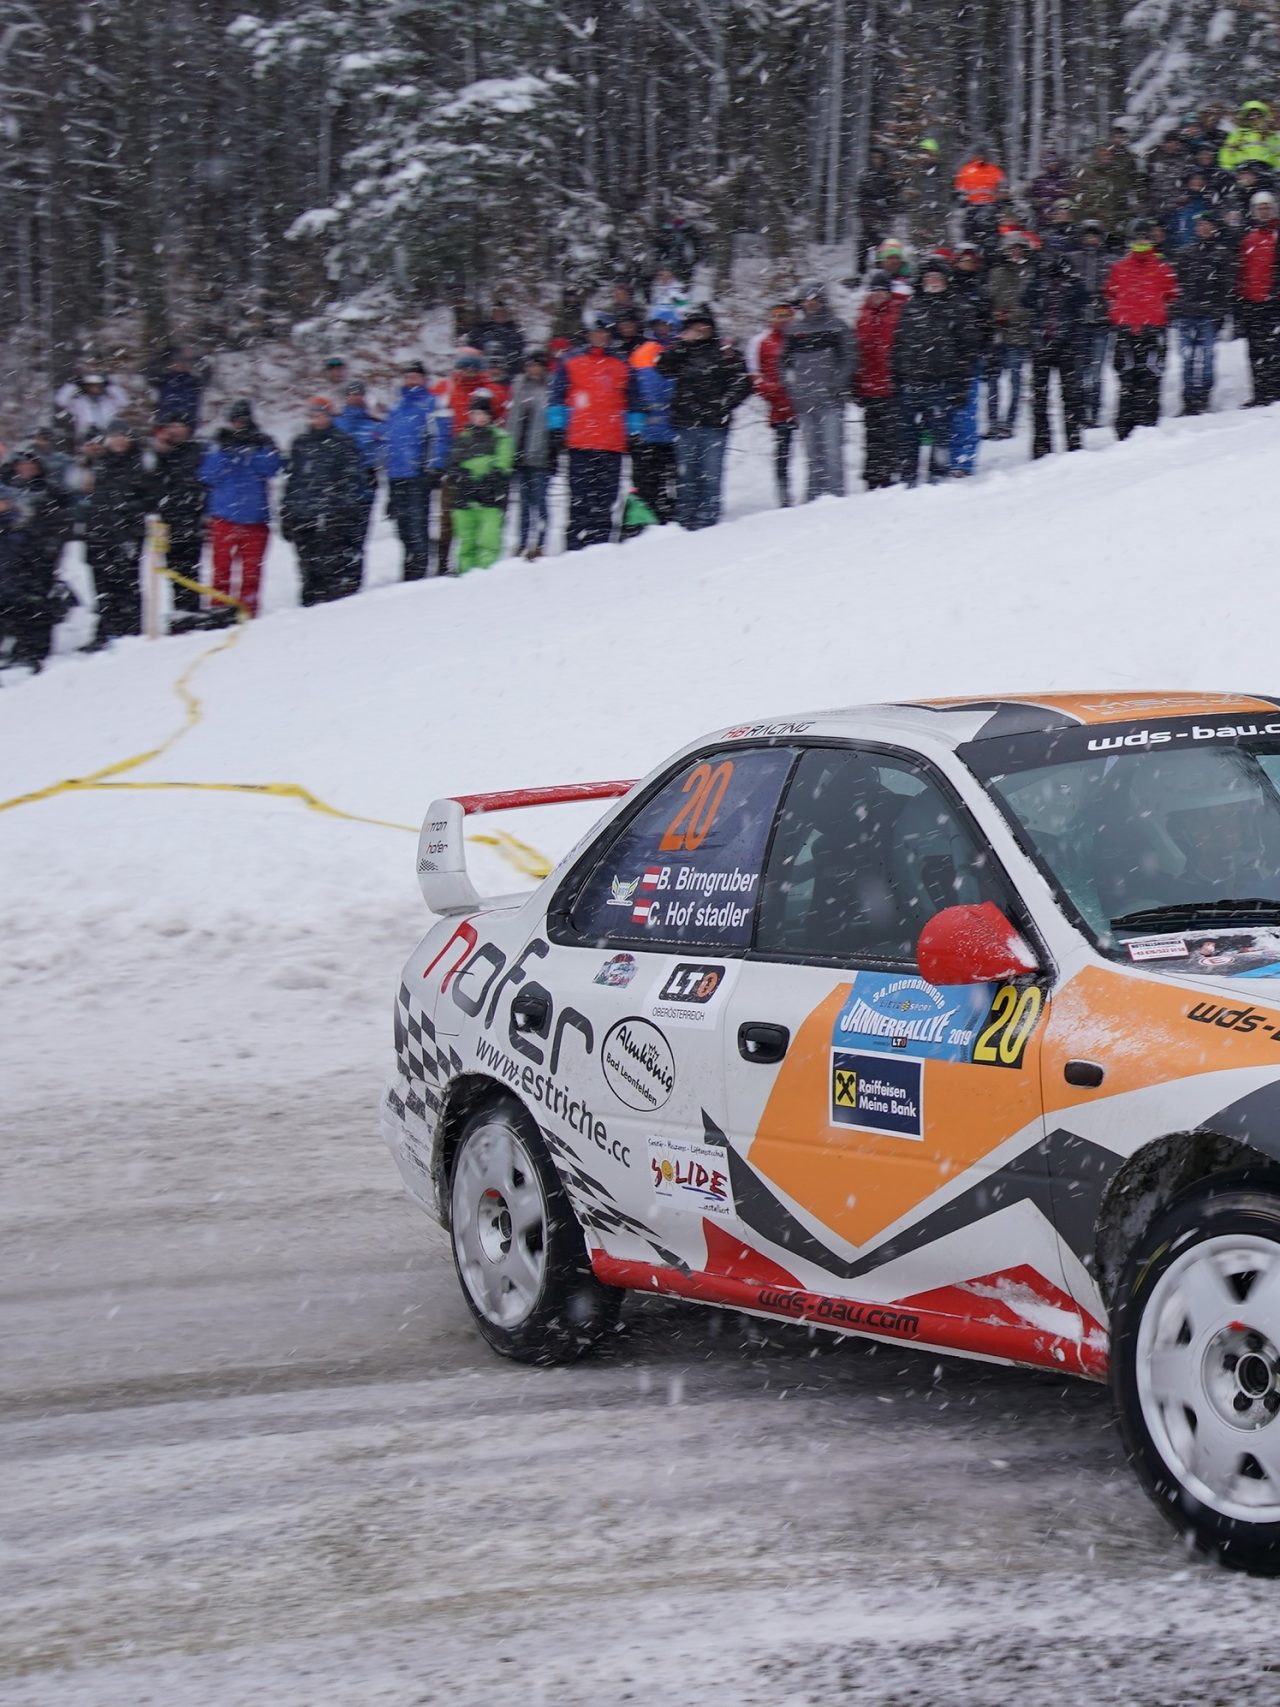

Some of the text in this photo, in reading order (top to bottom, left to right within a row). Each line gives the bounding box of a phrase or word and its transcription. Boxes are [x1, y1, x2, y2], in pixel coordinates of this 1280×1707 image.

[658, 760, 735, 852] 20
[657, 866, 672, 891] B.
[675, 866, 758, 897] Birngruber
[647, 902, 662, 926] C.
[947, 1028, 973, 1046] 2019
[974, 985, 1041, 1064] 20
[606, 1052, 657, 1106] Bad Leonfelden
[859, 1078, 907, 1099] Raiffeisen
[476, 1036, 631, 1168] www.estriche.cc
[859, 1095, 917, 1118] Meine Bank
[758, 1290, 919, 1334] wds-bau.com
